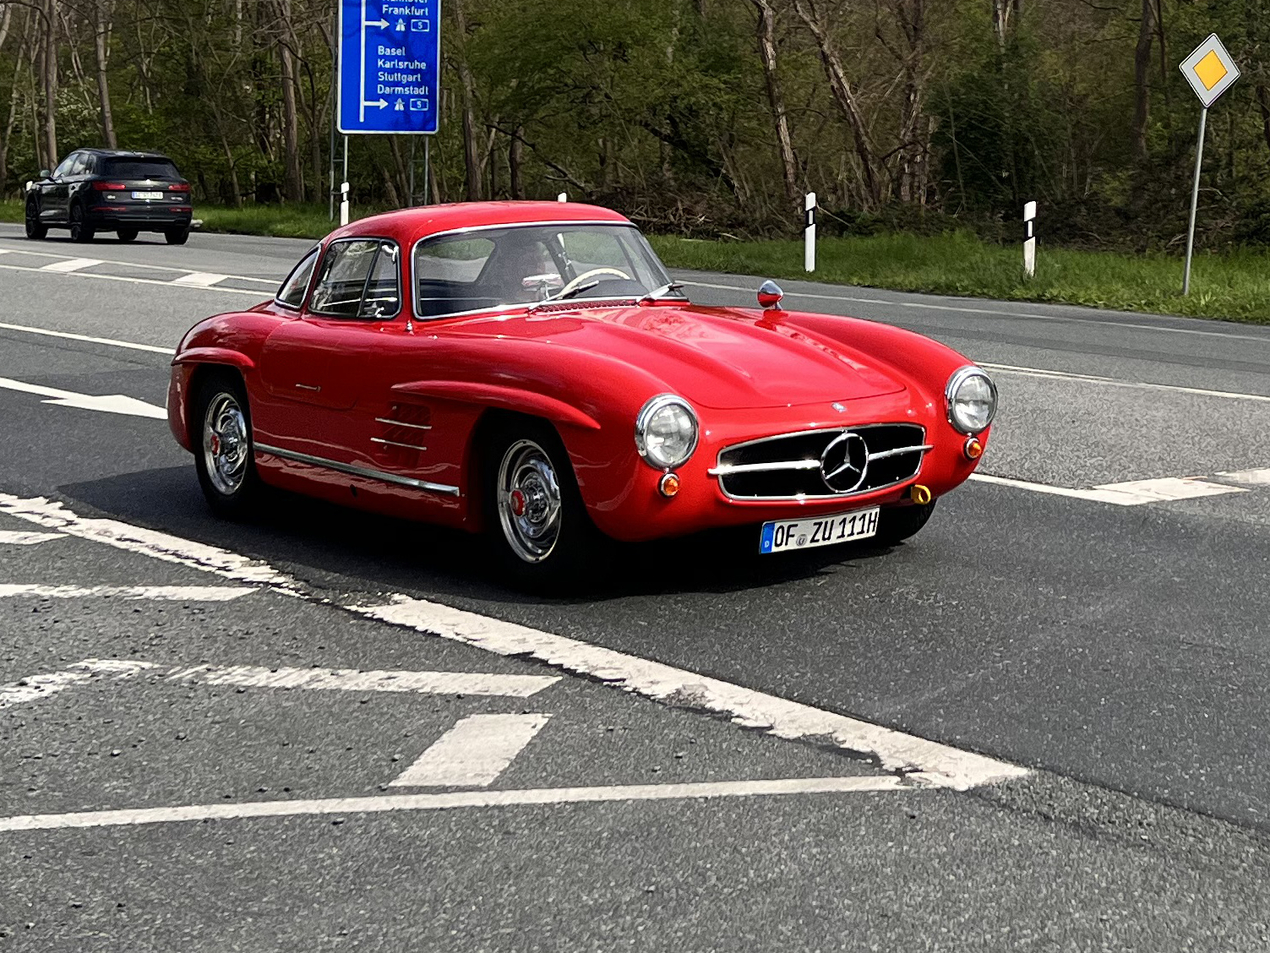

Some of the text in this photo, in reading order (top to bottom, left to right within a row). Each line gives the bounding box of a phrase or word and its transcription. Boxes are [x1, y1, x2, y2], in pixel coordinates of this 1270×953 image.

[382, 5, 429, 16] Frankfurt
[377, 45, 406, 56] Basel
[377, 58, 427, 70] Karlsruhe
[378, 71, 421, 83] Stuttgart
[377, 84, 429, 95] Darmstadt
[774, 511, 878, 547] OF ZU 111H
